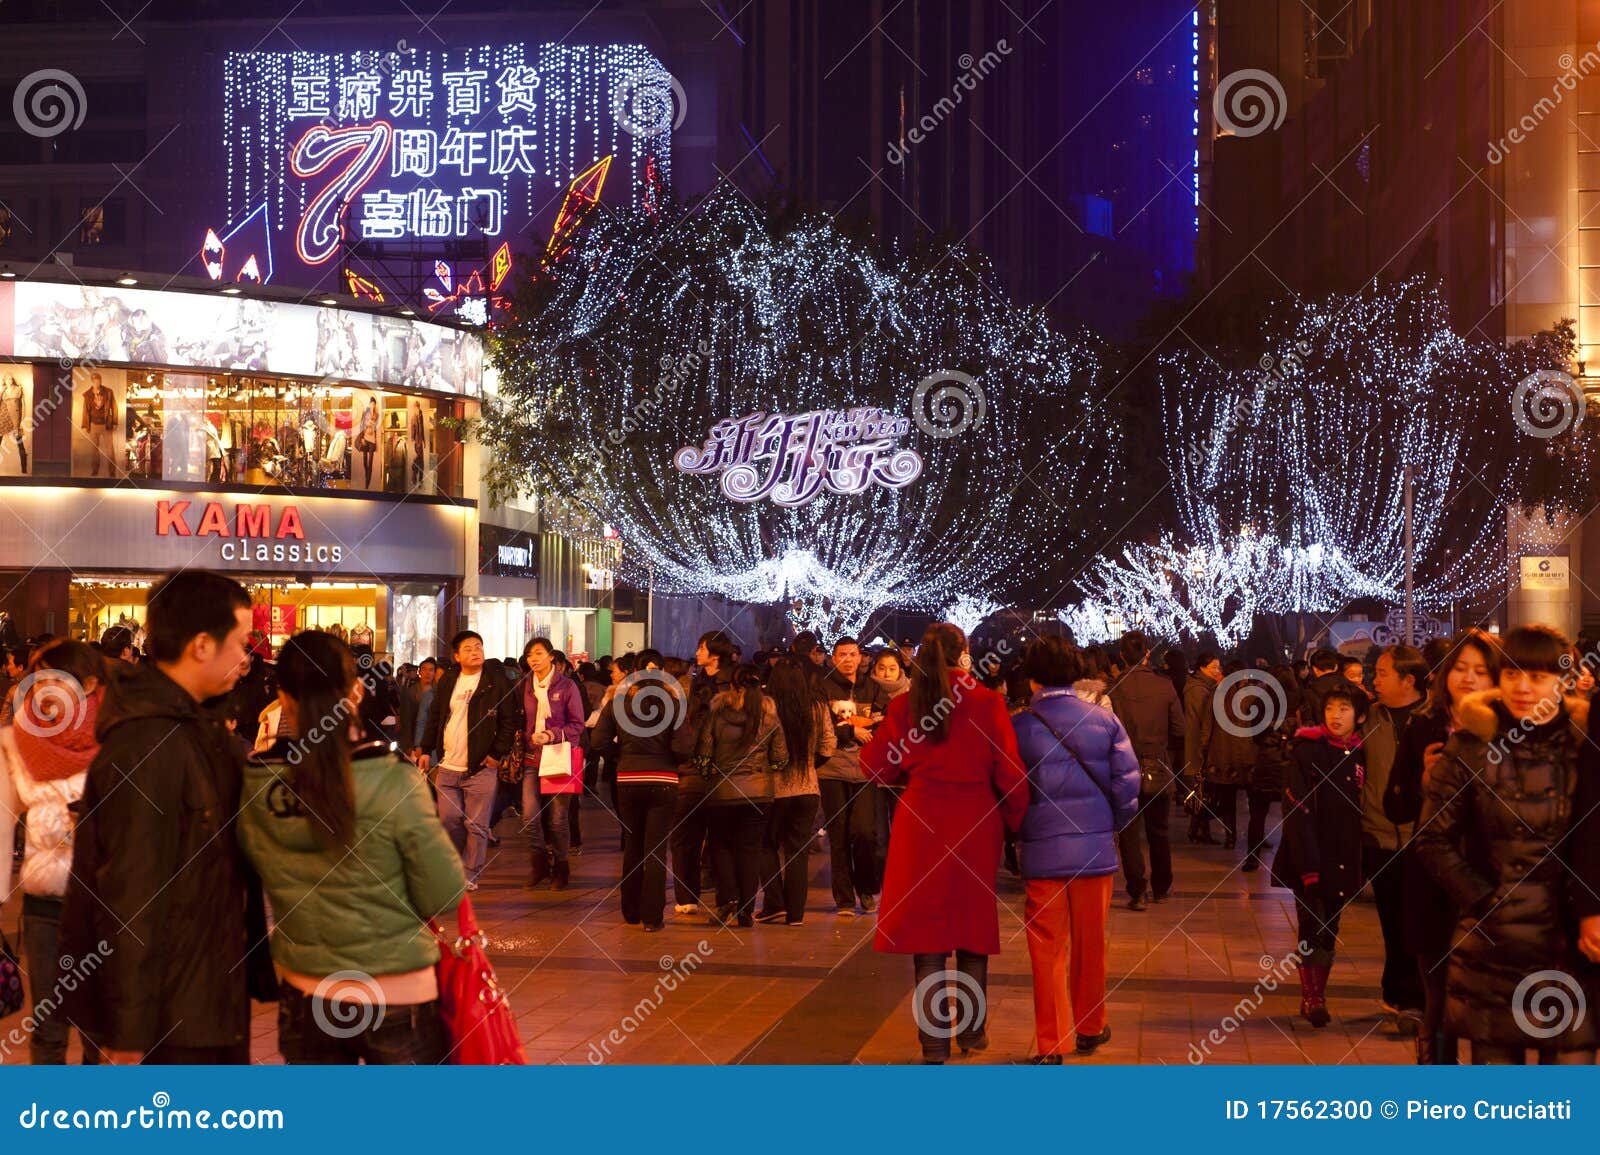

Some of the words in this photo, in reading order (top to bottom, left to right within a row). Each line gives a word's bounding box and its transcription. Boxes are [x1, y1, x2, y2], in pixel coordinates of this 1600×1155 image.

[288, 65, 541, 119] 王府井百货
[360, 187, 502, 239] 喜临门
[821, 424, 858, 440] NEW
[866, 419, 909, 436] YEAR
[824, 407, 884, 426] HAPPY
[674, 409, 924, 506] 新年快乐
[156, 501, 305, 540] KAMA
[222, 539, 342, 563] classics
